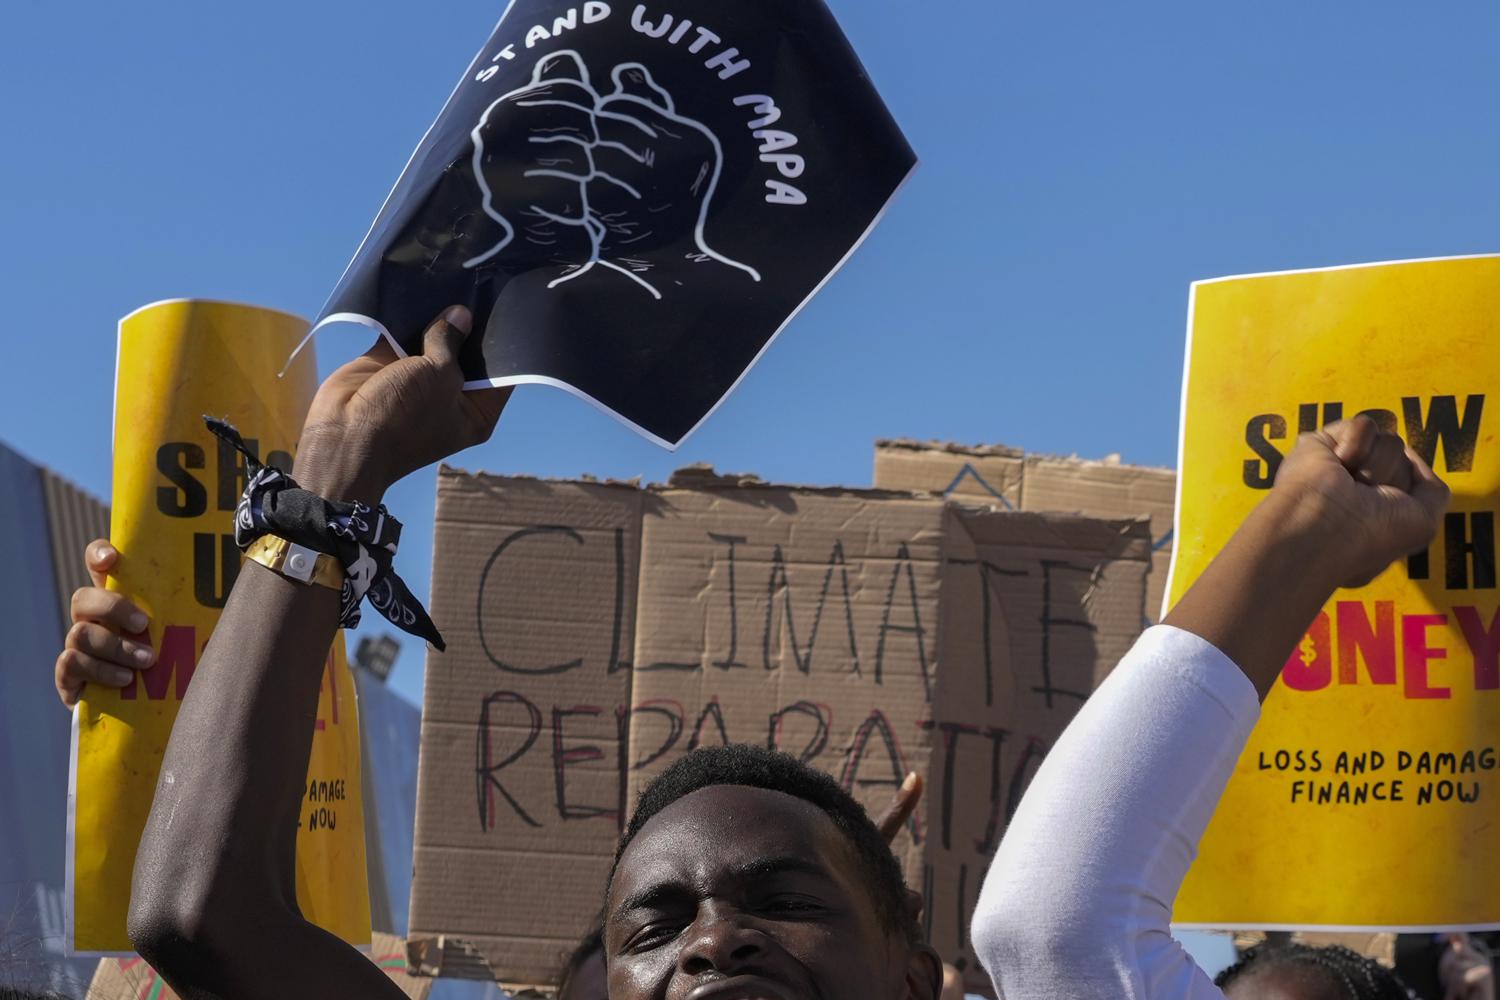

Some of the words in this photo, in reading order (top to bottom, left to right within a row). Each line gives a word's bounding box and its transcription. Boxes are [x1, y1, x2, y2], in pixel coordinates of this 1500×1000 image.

[475, 1, 612, 83] STAND
[630, 4, 751, 80] WITH
[733, 94, 807, 206] MAPA
[156, 439, 300, 518] SH
[1242, 394, 1485, 489] SW
[477, 524, 1103, 710] CLIMATE
[304, 779, 345, 802] AMAGE
[476, 691, 1048, 854] REPATI
[1259, 750, 1322, 772] LOSS
[1336, 751, 1385, 775] AND
[1291, 780, 1404, 805] FINANCE
[1418, 781, 1480, 805] NOW
[309, 807, 337, 832] NOW
